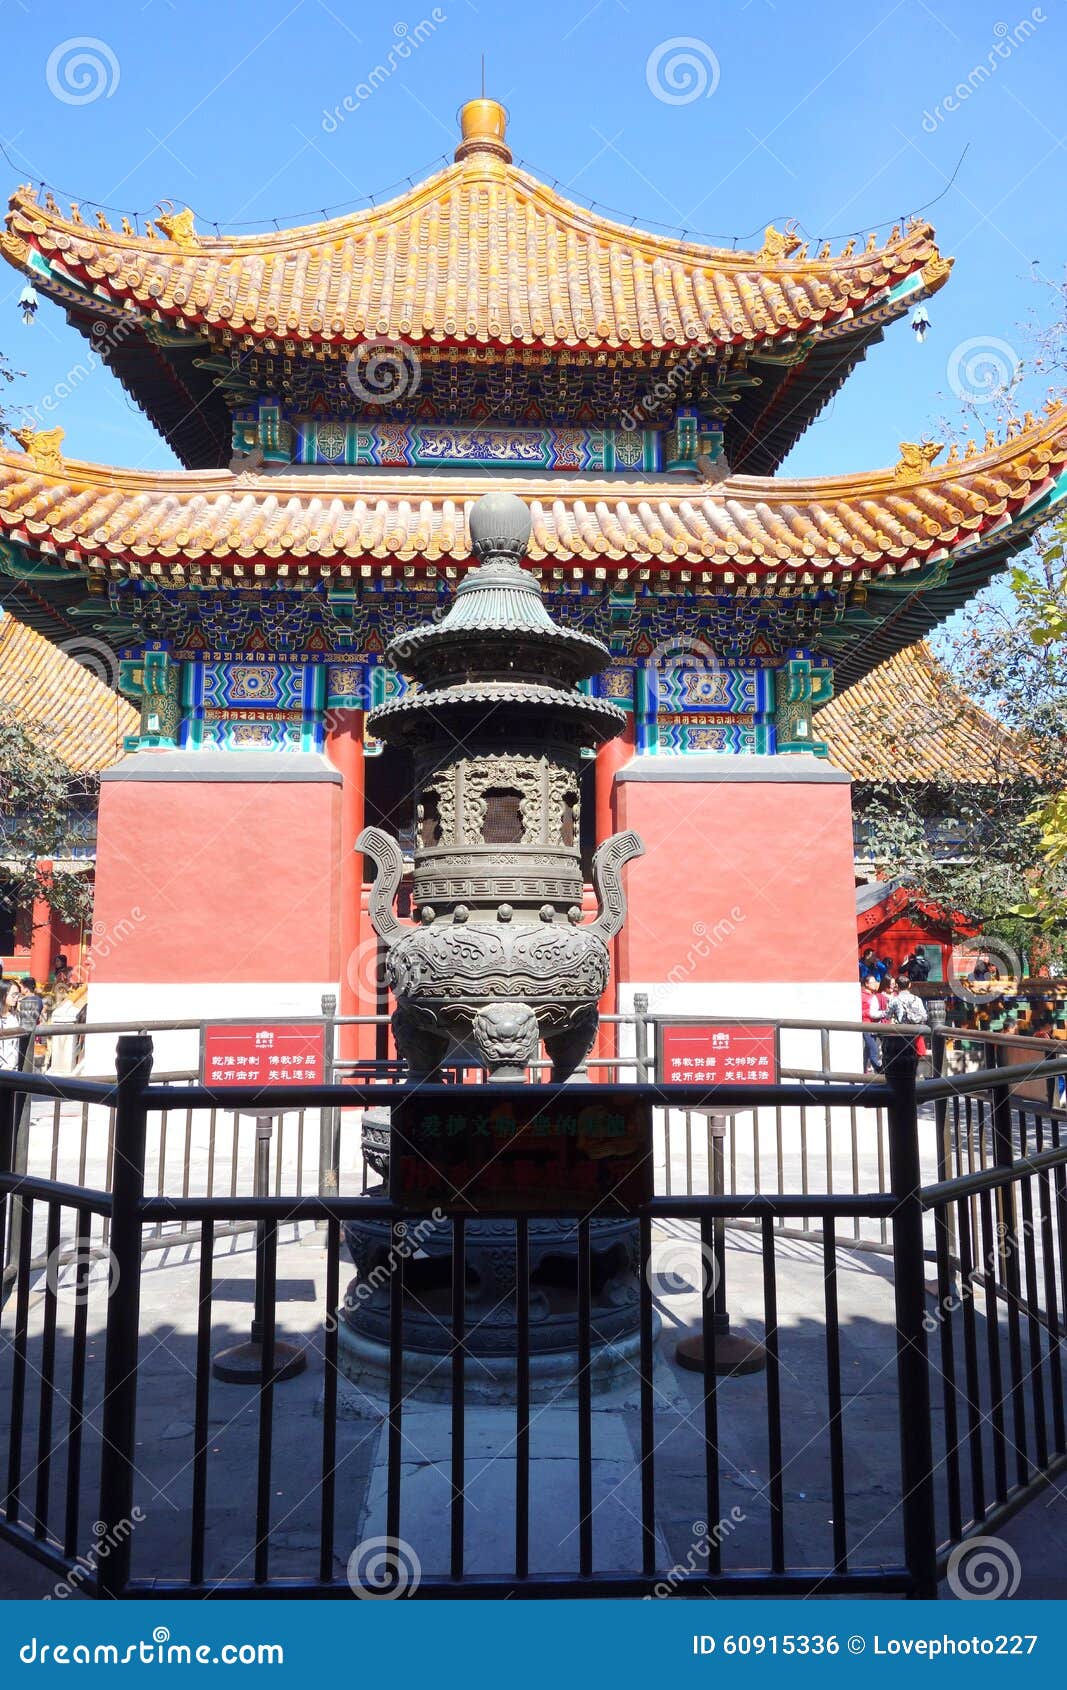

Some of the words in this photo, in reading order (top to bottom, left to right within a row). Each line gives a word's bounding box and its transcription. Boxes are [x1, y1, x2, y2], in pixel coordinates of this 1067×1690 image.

[268, 1055, 316, 1066] 佛教珍品
[724, 1056, 769, 1067] 文物珍品
